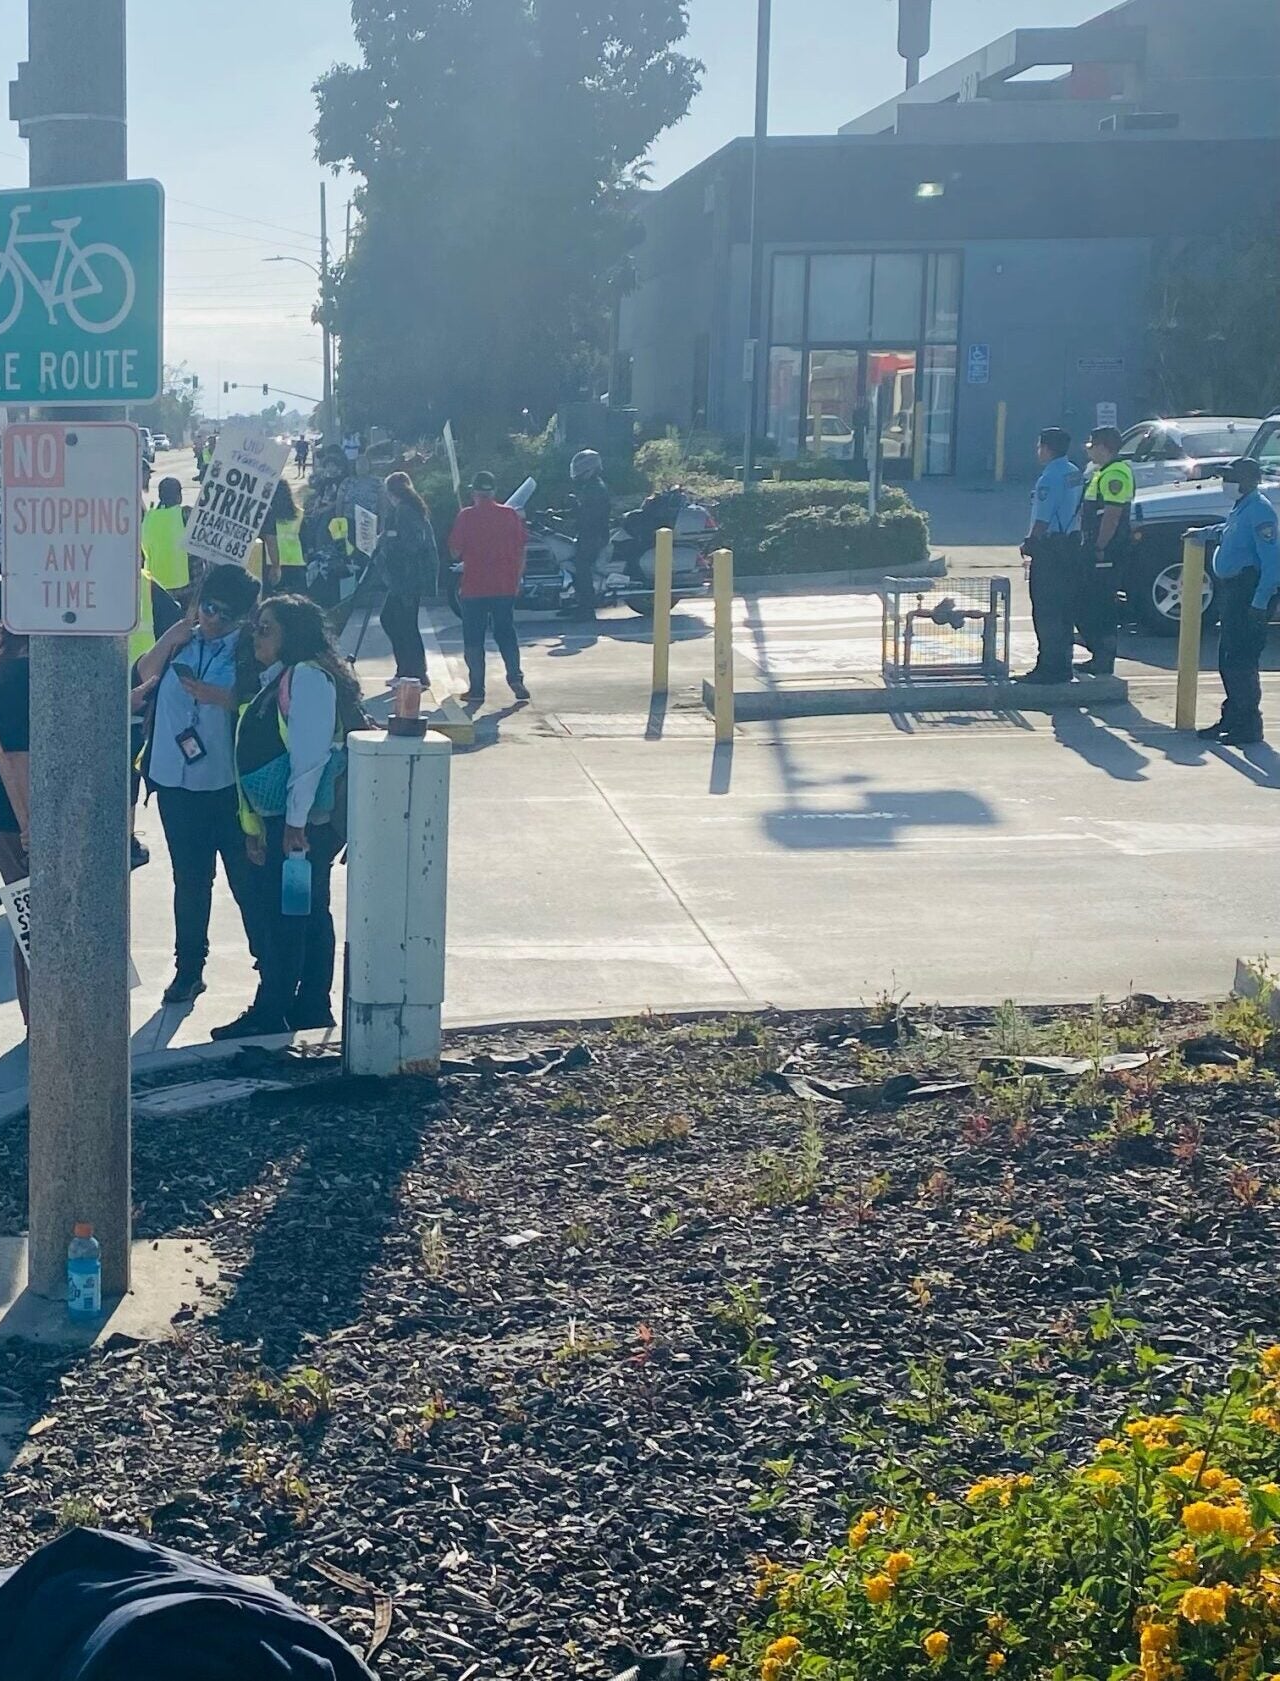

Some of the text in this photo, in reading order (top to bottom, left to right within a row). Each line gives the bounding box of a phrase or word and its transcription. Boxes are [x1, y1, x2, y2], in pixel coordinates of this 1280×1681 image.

[40, 349, 139, 390] ROUTE
[13, 434, 57, 480] NO
[225, 468, 258, 495] ON
[12, 497, 130, 536] STOPPING
[198, 479, 268, 530] STRIKE
[191, 525, 224, 550] LOCAL
[224, 541, 248, 559] 683
[195, 509, 255, 544] TEAMSTERS
[44, 544, 94, 571] ANY
[41, 580, 97, 609] TIME
